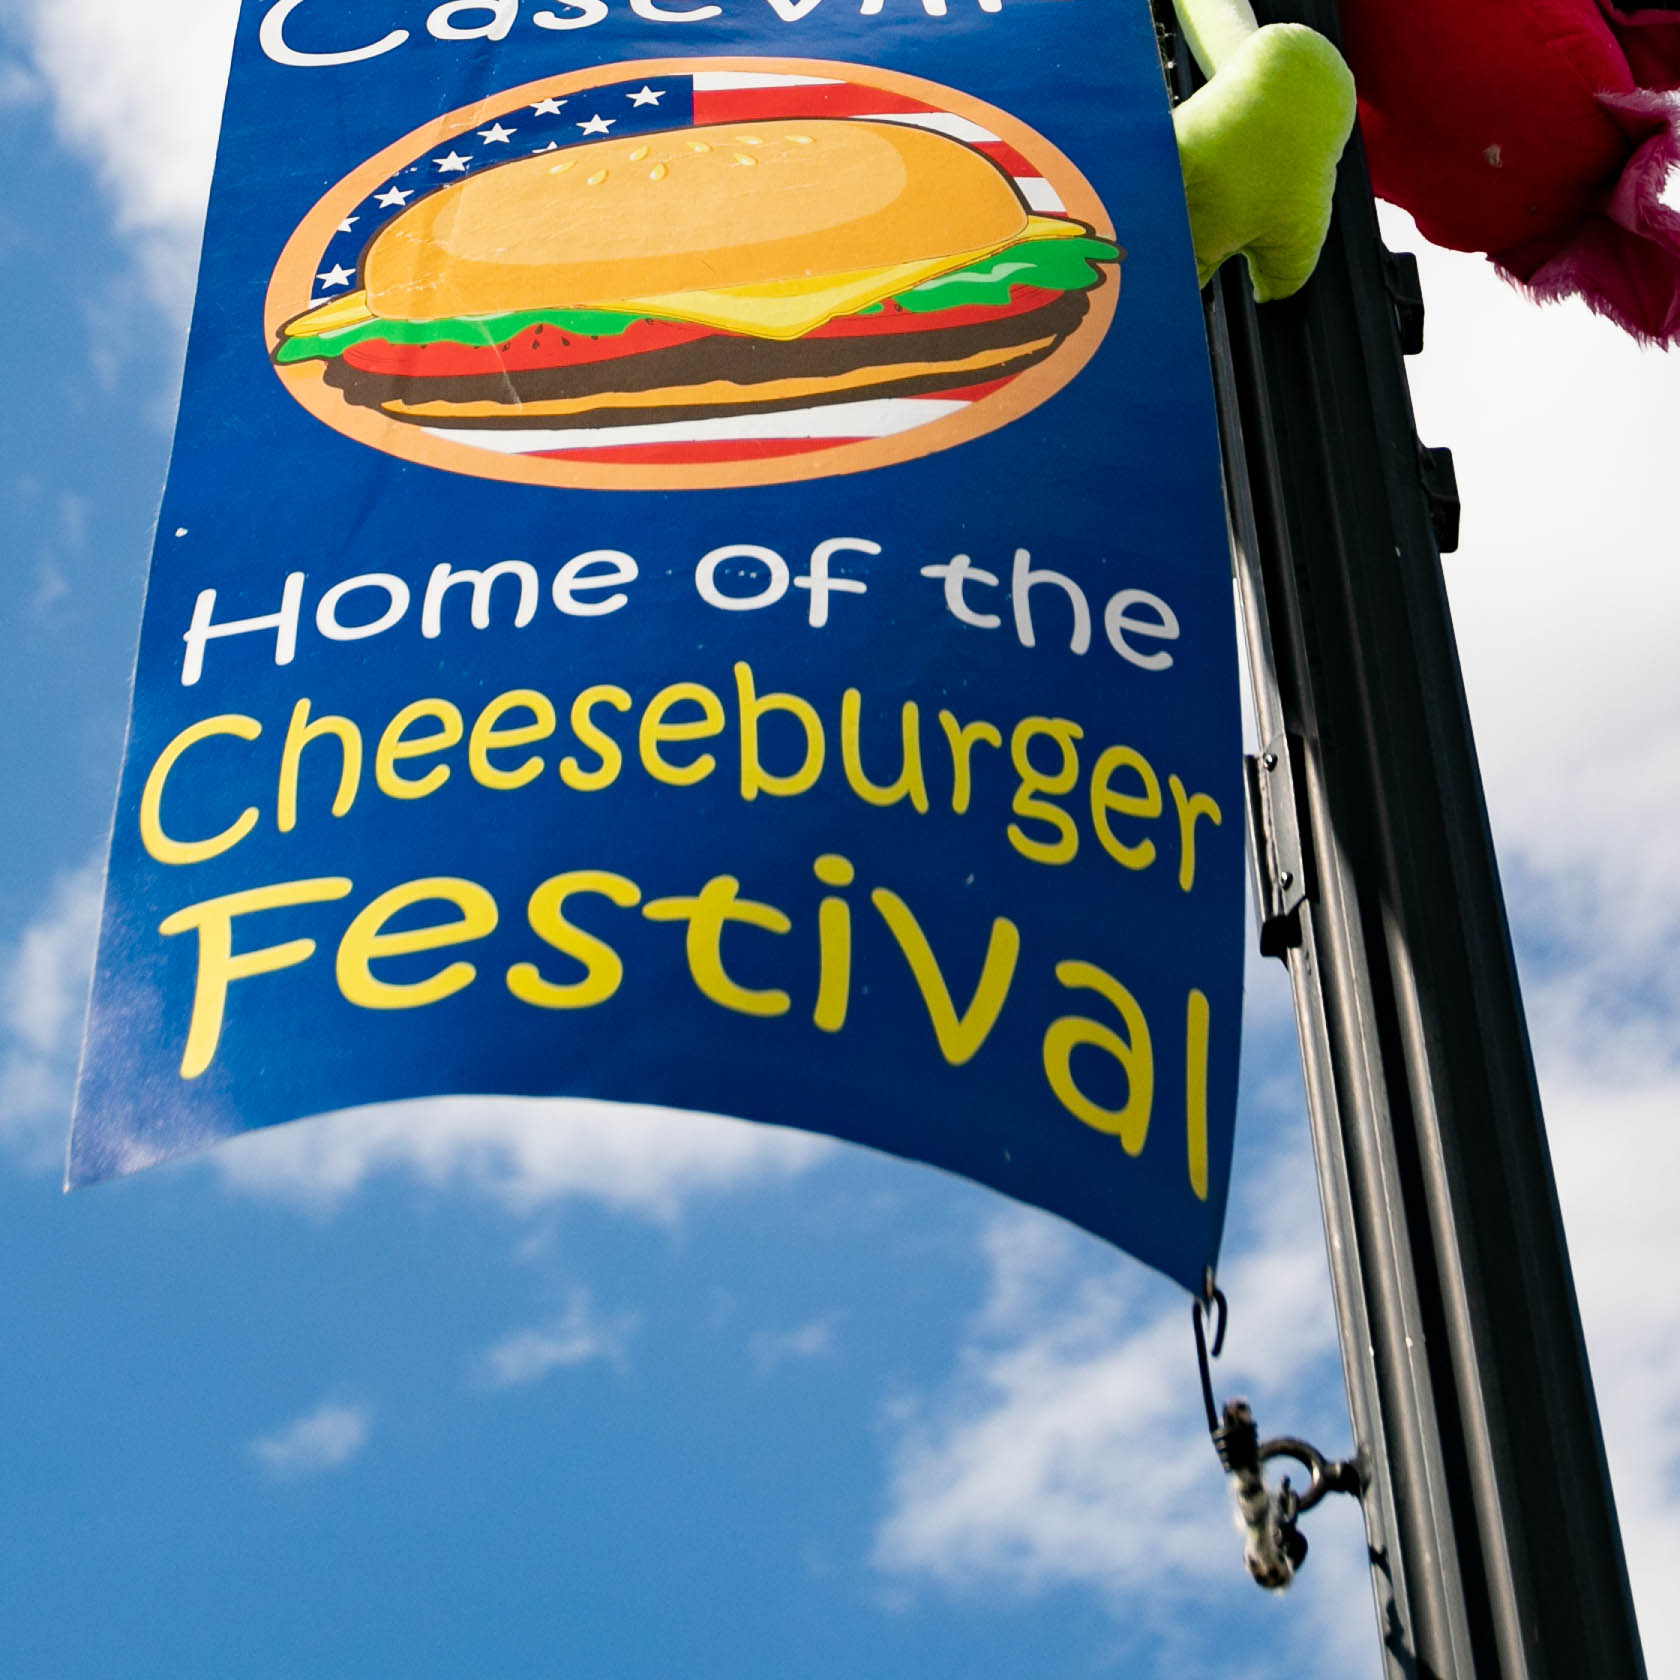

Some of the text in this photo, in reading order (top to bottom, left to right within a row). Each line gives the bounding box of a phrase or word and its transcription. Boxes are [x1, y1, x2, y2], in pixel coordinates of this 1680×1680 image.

[179, 536, 1181, 688] Home of the
[138, 660, 1223, 892] Cheeseburger
[157, 853, 1210, 1200] Festival
